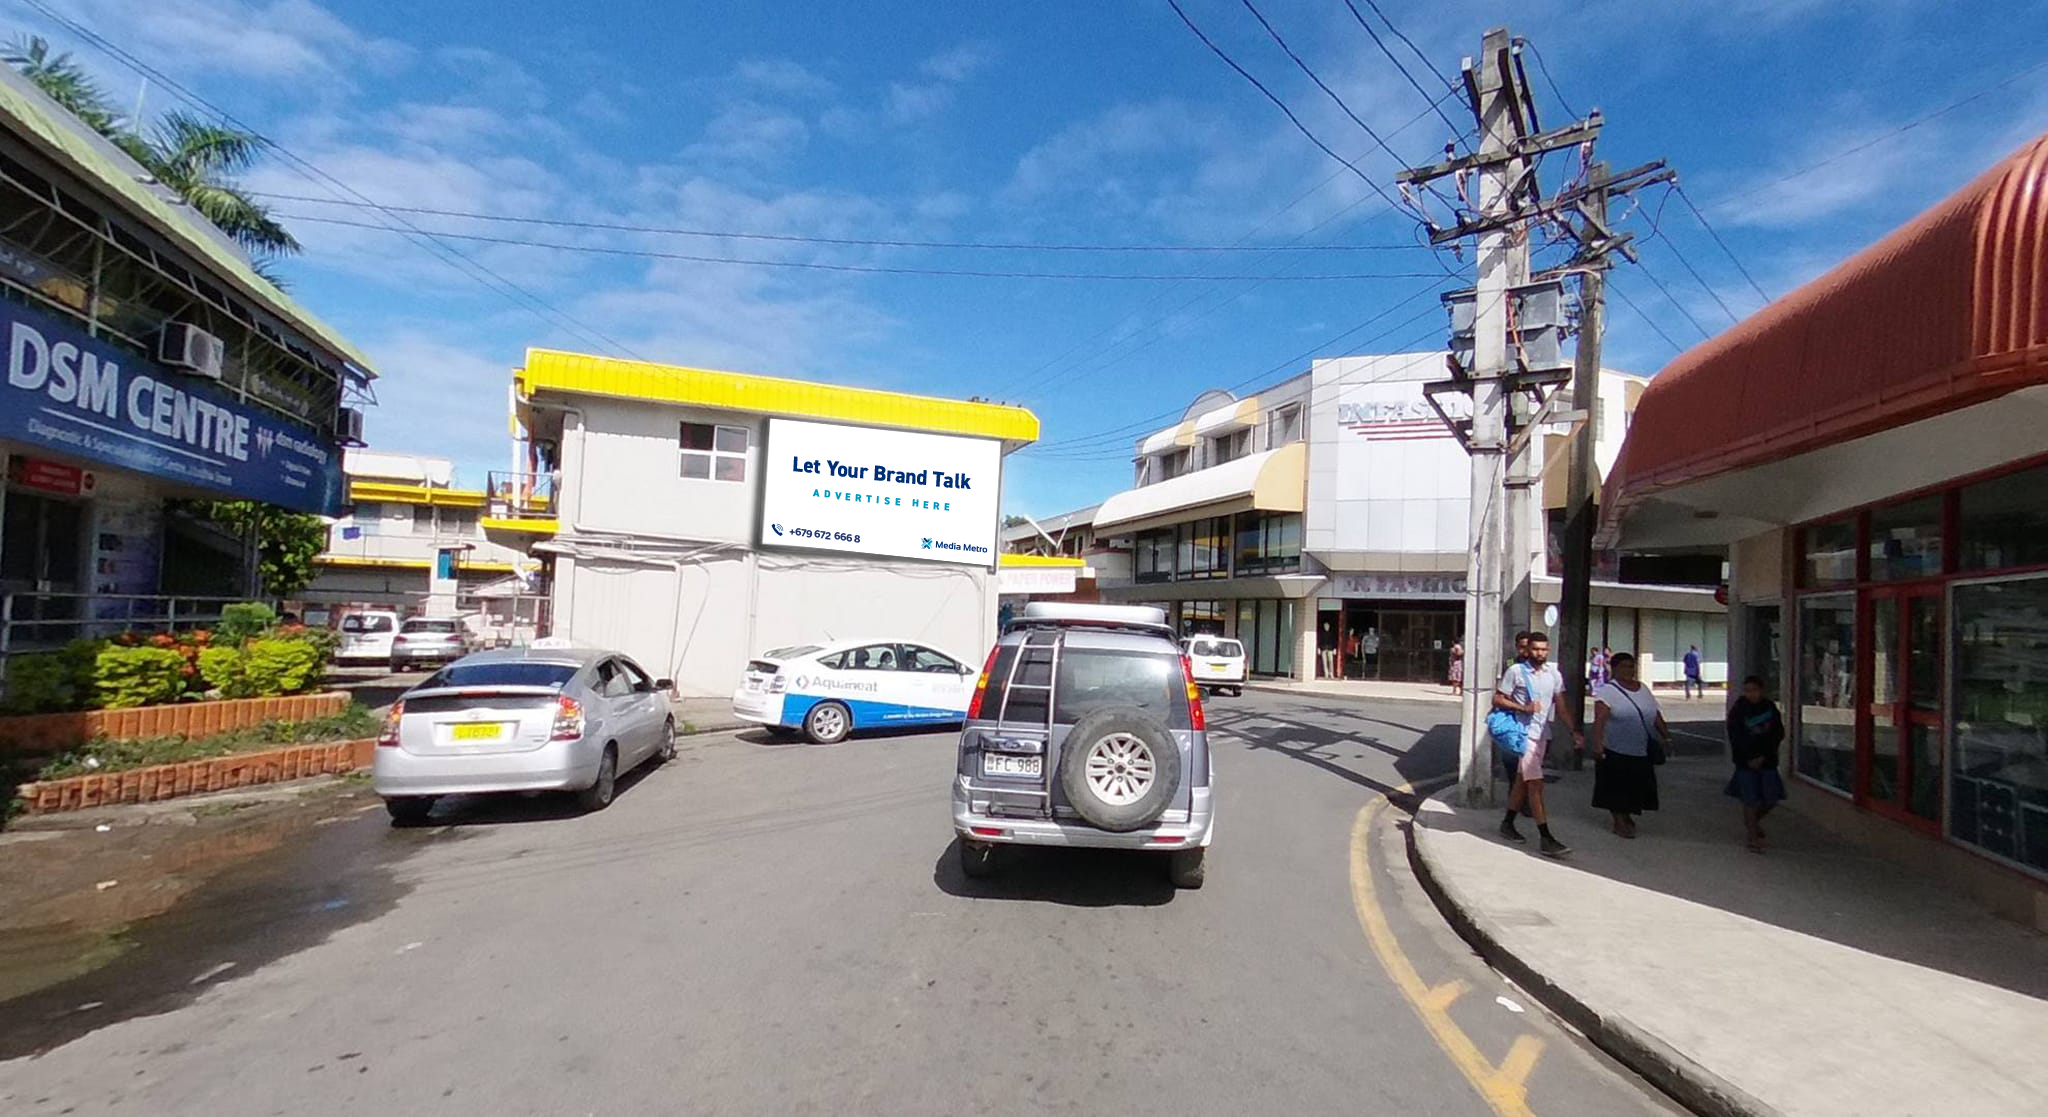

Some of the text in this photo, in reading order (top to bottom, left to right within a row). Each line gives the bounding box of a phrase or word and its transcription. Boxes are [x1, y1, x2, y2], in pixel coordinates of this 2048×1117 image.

[9, 322, 119, 419] DSM
[127, 375, 250, 462] CENTRE
[792, 456, 972, 490] Let Your Brand Talk
[812, 488, 951, 512] ADVERTISE HERE
[789, 527, 813, 538] +679
[814, 530, 832, 541] 672
[935, 540, 988, 553] Media Metro
[995, 757, 1012, 772] FC
[1017, 758, 1040, 774] 988
